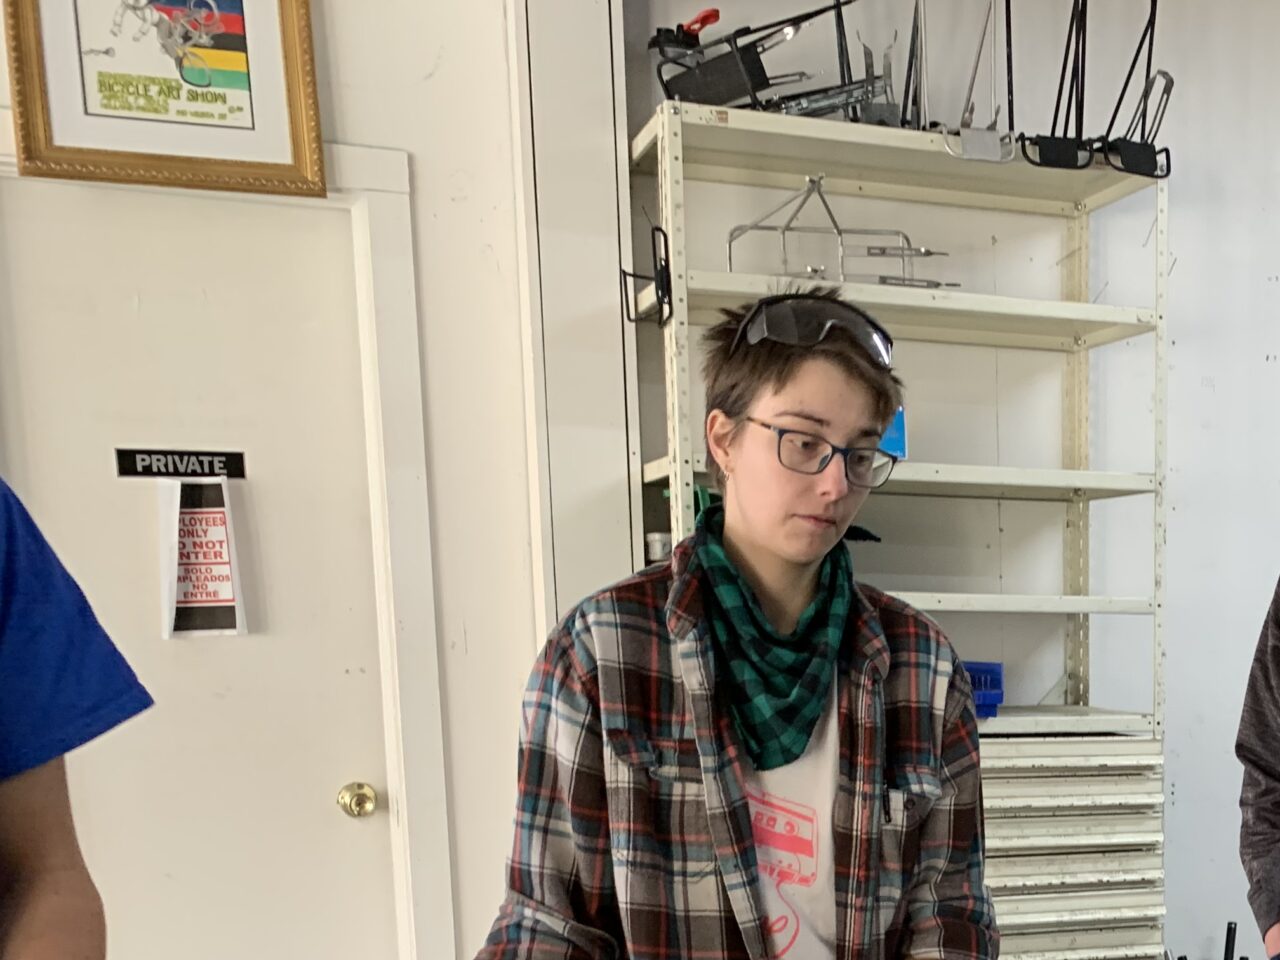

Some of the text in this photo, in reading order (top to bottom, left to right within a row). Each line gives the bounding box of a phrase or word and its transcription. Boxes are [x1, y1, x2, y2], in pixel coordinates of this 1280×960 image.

[98, 79, 151, 97] BICYCLE
[158, 85, 181, 100] ART
[186, 89, 227, 104] SHOW
[135, 454, 228, 474] PRIVATE
[180, 516, 226, 527] LOYEES
[179, 528, 209, 539] ONLY
[192, 540, 225, 550] NOT
[179, 551, 224, 561] NTER
[184, 567, 213, 575] SOLO
